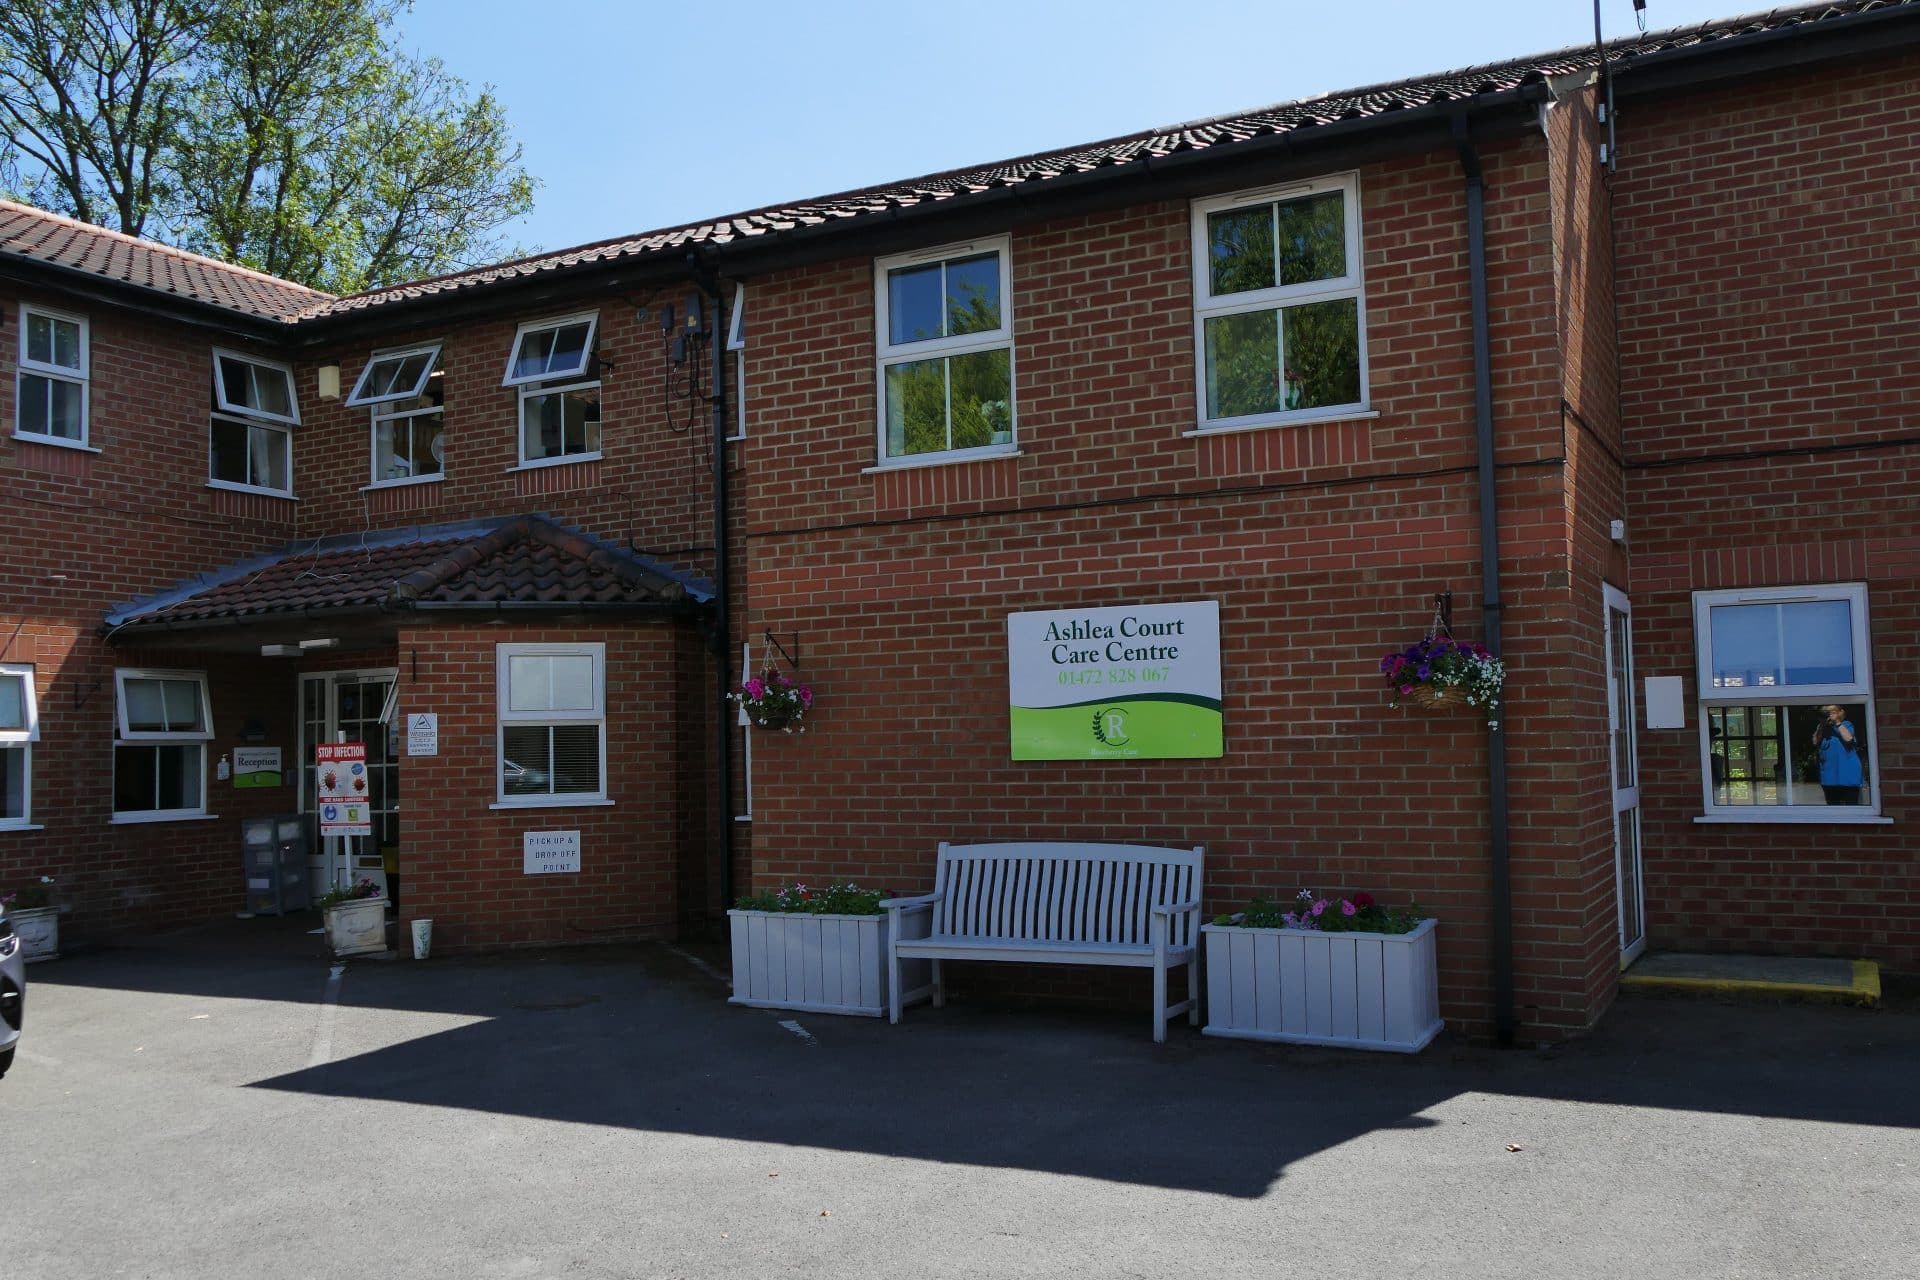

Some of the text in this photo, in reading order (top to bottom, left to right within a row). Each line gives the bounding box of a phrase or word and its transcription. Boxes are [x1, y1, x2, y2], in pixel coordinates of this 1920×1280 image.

[1043, 616, 1185, 642] Ashlea Court
[1051, 641, 1179, 665] Care Centre
[1057, 667, 1170, 687] 01472 828 067
[1105, 714, 1127, 739] R
[318, 745, 365, 758] STOP INFECTION
[238, 757, 278, 768] Reception
[529, 837, 551, 846] PICK
[535, 851, 557, 859] DROP
[543, 863, 571, 872] POINT
